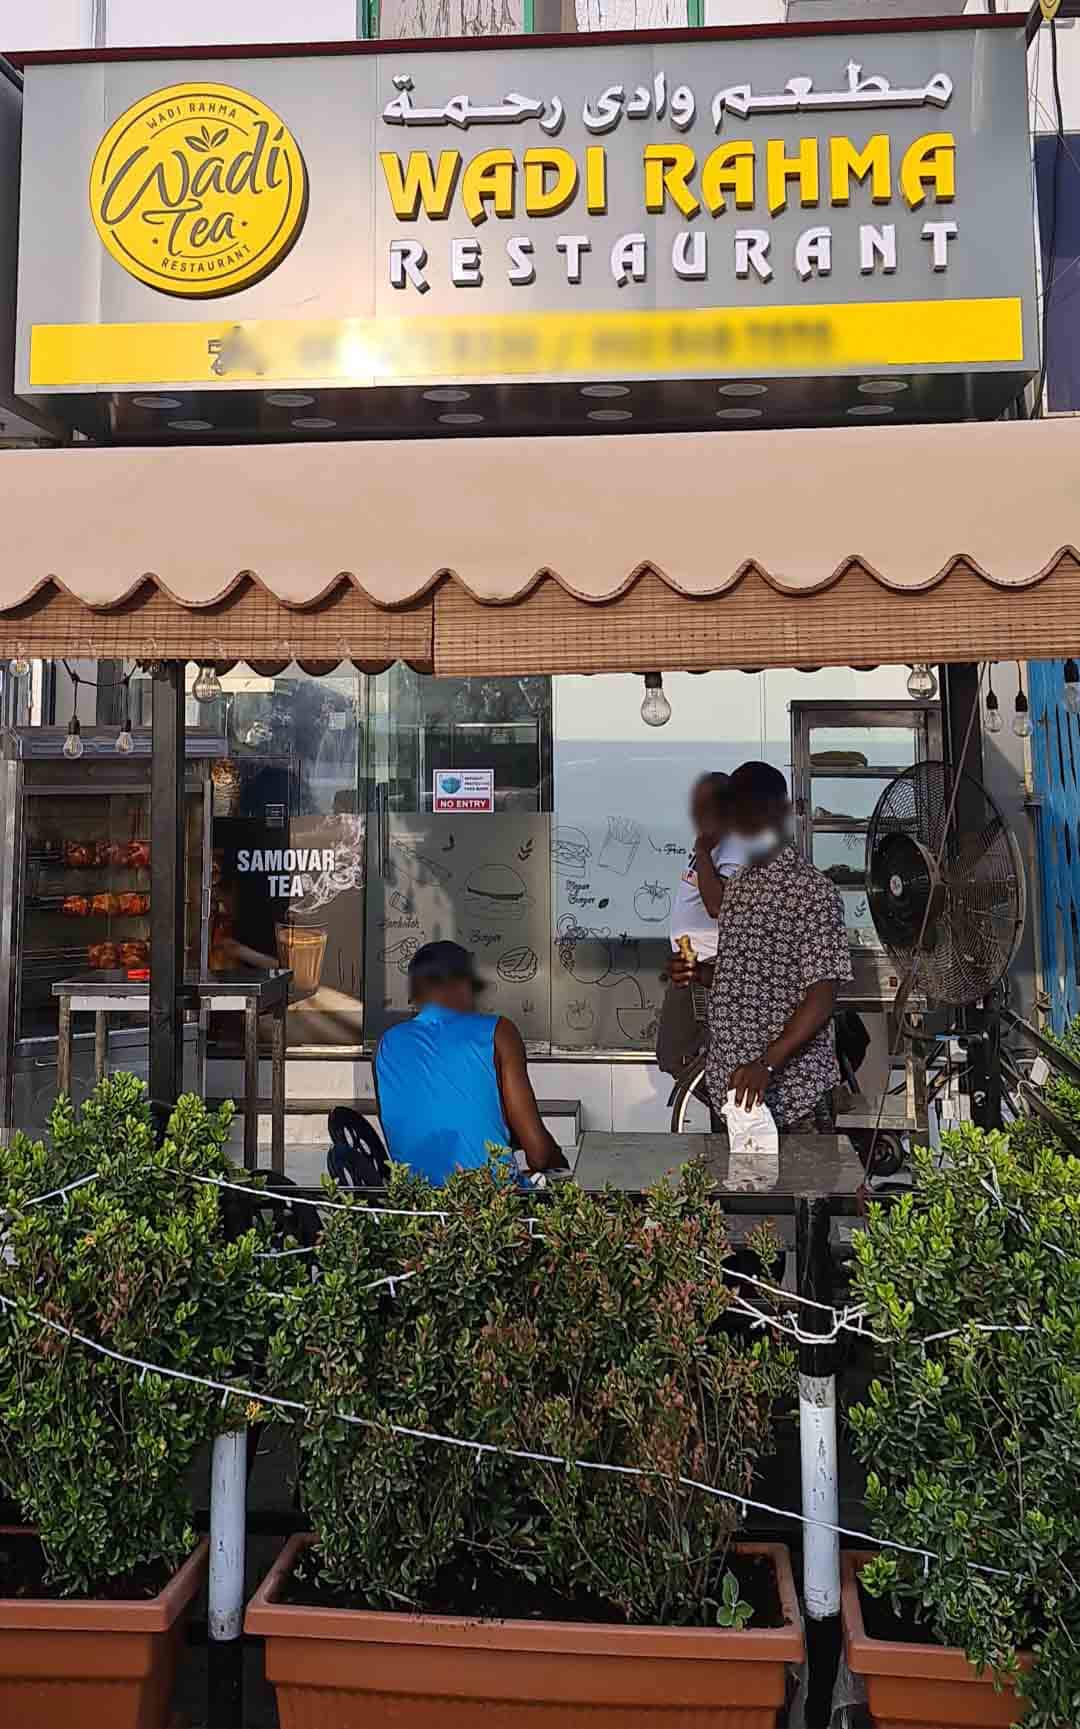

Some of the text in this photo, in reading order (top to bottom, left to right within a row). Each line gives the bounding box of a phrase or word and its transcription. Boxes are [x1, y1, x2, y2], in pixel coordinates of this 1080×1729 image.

[146, 102, 237, 129] WADI RAHMA
[382, 73, 566, 137] رحمة
[711, 59, 953, 135] مطعم
[100, 120, 284, 225] Wadi
[379, 132, 957, 227] WADI RAHMA
[141, 198, 236, 257] Tea
[160, 244, 252, 274] RESTAURANT
[388, 221, 959, 294] RESTAURANT
[440, 799, 487, 809] NO ENTRY
[236, 848, 336, 873] SAMOVAR
[267, 874, 305, 898] TEA
